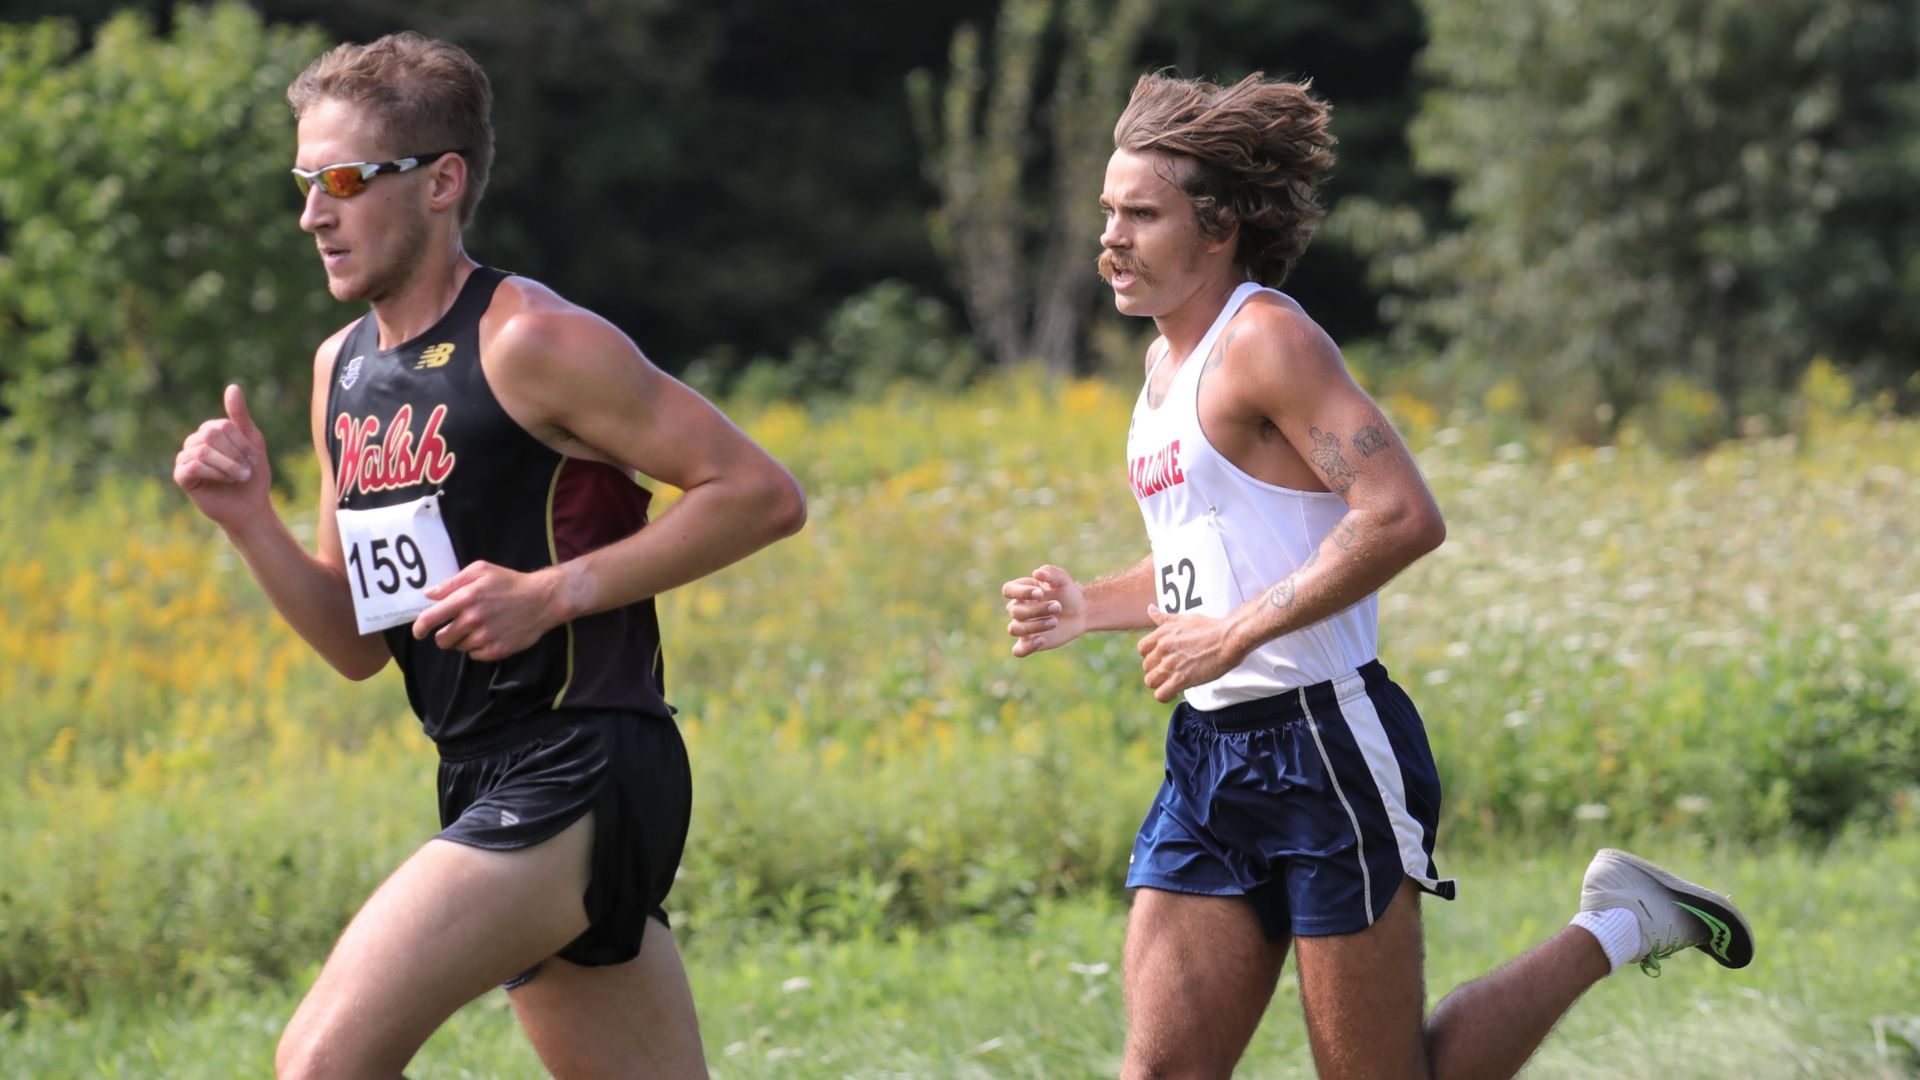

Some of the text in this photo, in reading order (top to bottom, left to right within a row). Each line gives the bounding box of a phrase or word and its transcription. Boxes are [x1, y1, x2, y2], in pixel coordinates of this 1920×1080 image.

[335, 404, 455, 500] Walsh
[349, 534, 427, 598] 159
[1161, 558, 1203, 614] 52
